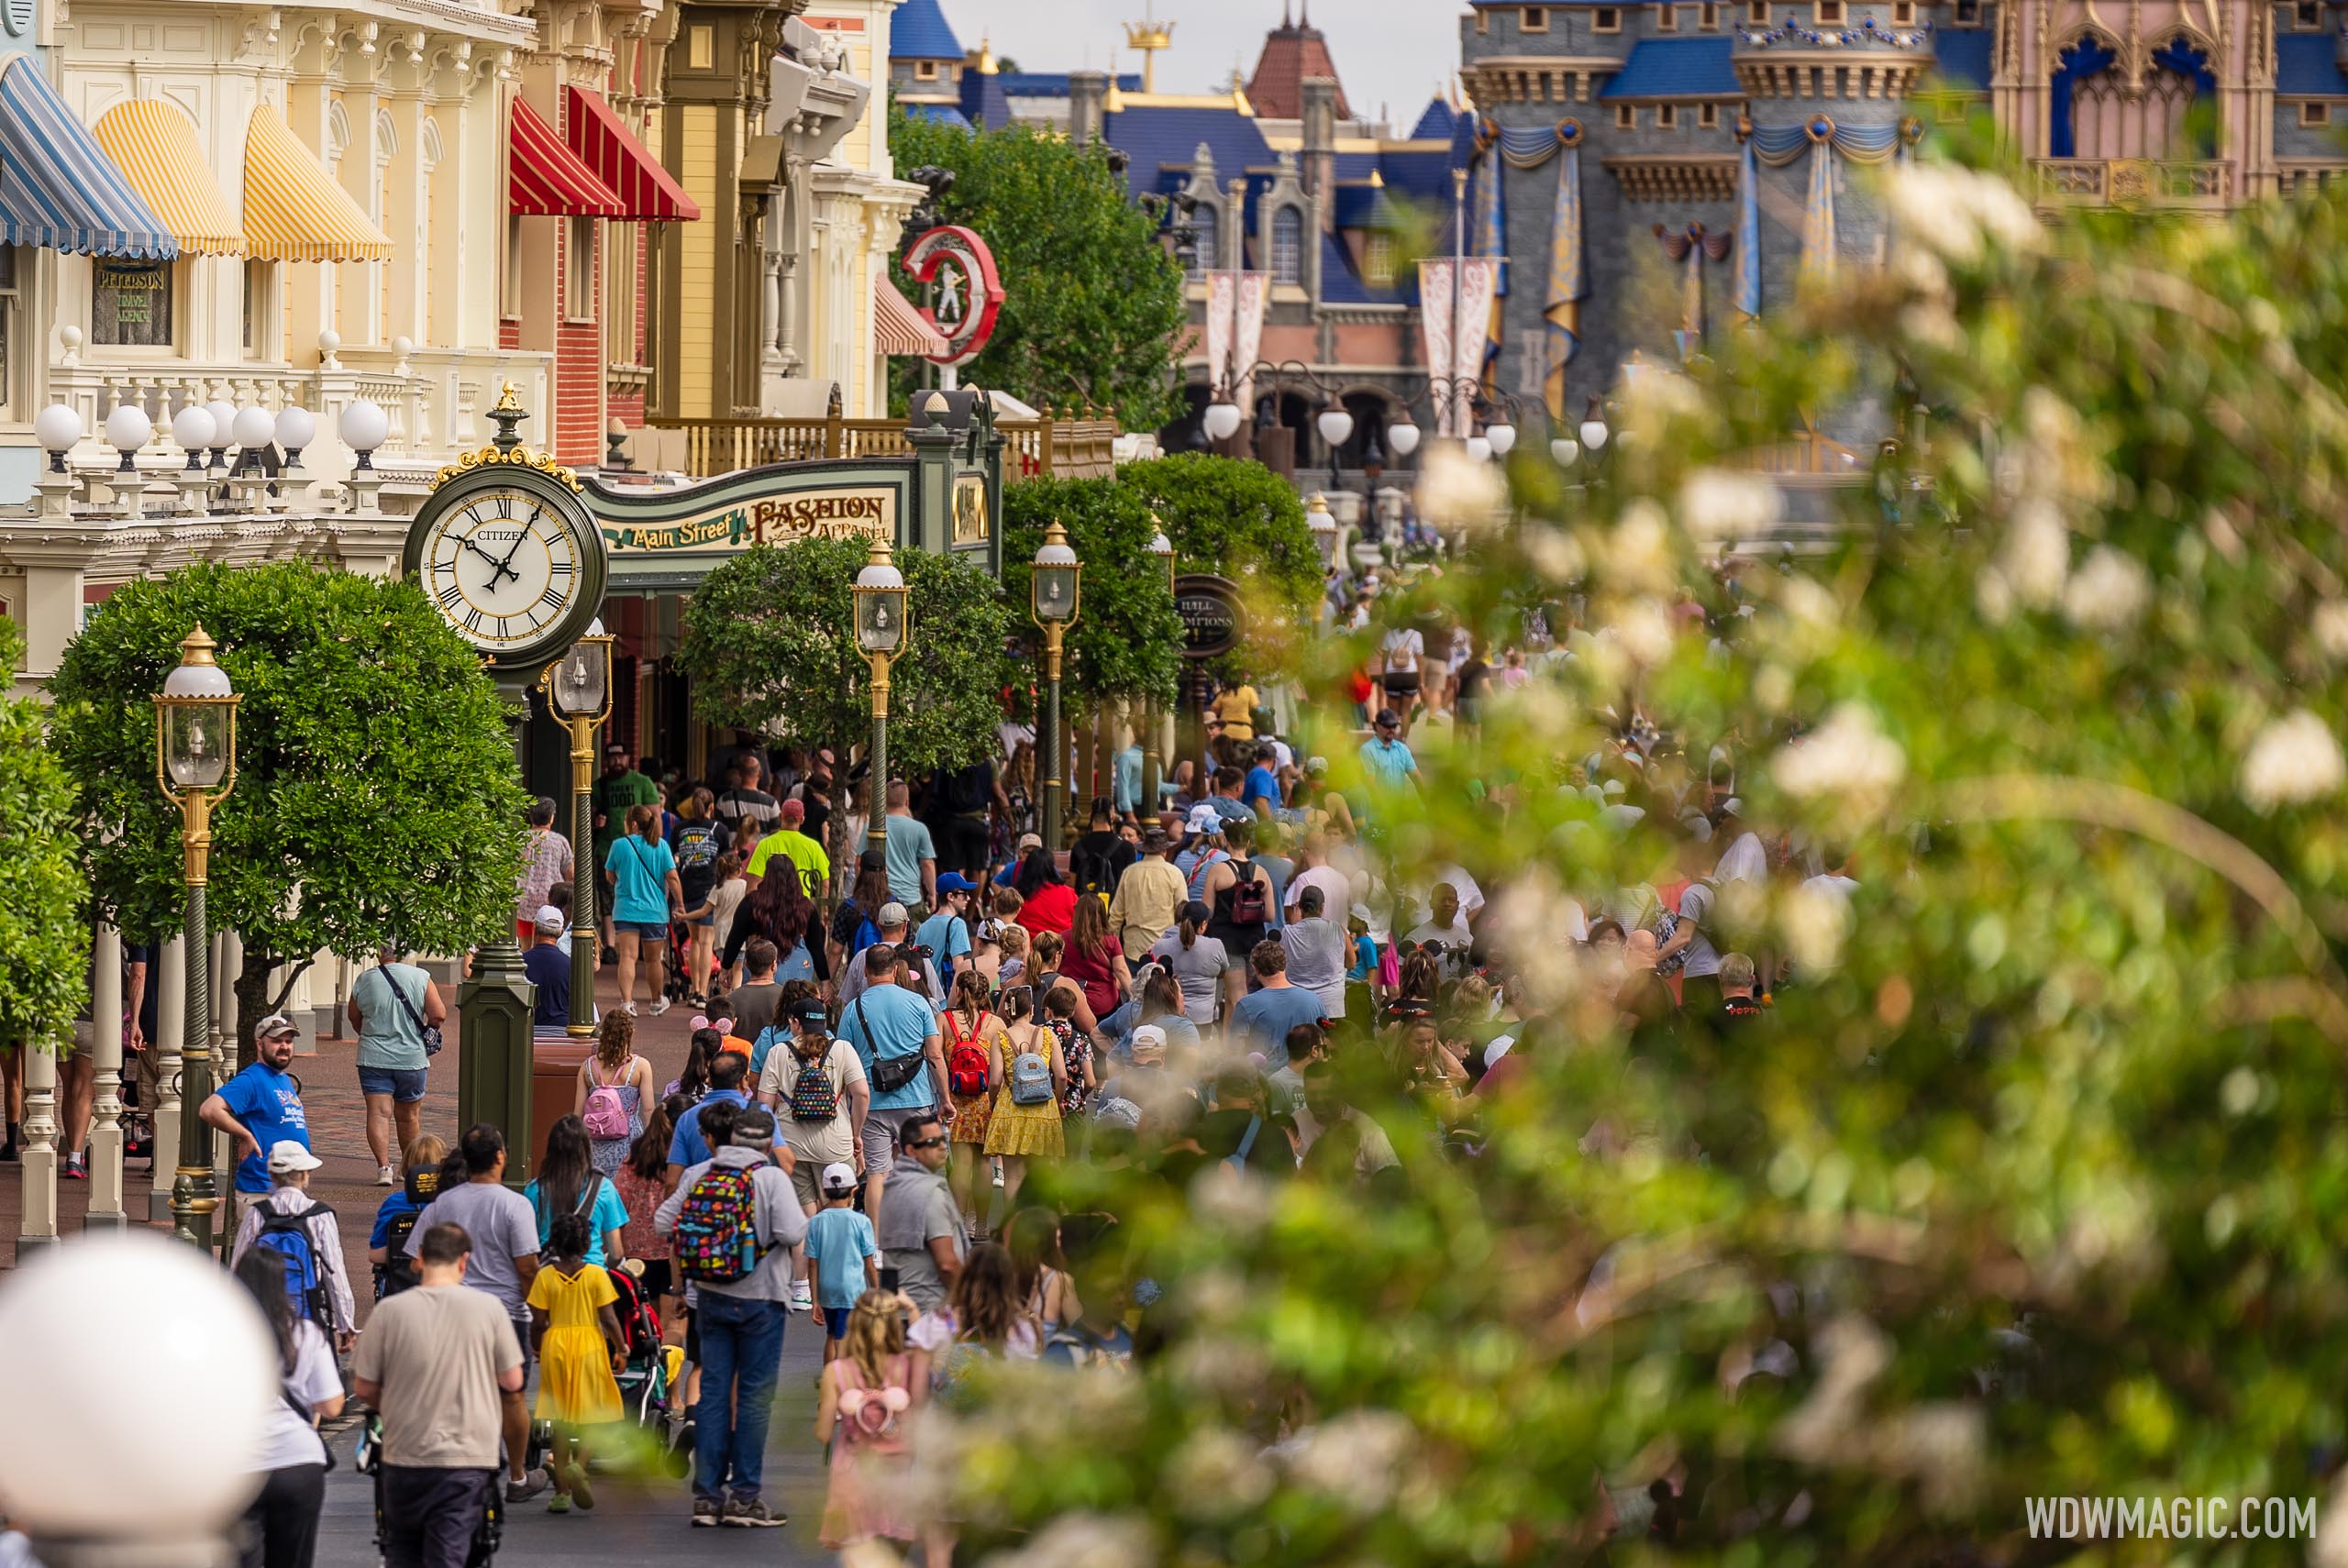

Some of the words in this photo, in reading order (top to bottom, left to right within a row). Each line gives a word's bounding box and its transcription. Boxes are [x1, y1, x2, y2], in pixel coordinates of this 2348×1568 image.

[99, 271, 164, 290] PETERSON
[116, 294, 148, 307] TRAVEL
[116, 310, 151, 322] AGENCY
[747, 496, 885, 545] FASHION
[477, 530, 528, 541] CITIZEN
[630, 527, 675, 551] Main
[679, 513, 733, 545] Street
[1181, 601, 1213, 611] HALL
[1185, 616, 1233, 627] MPIONS
